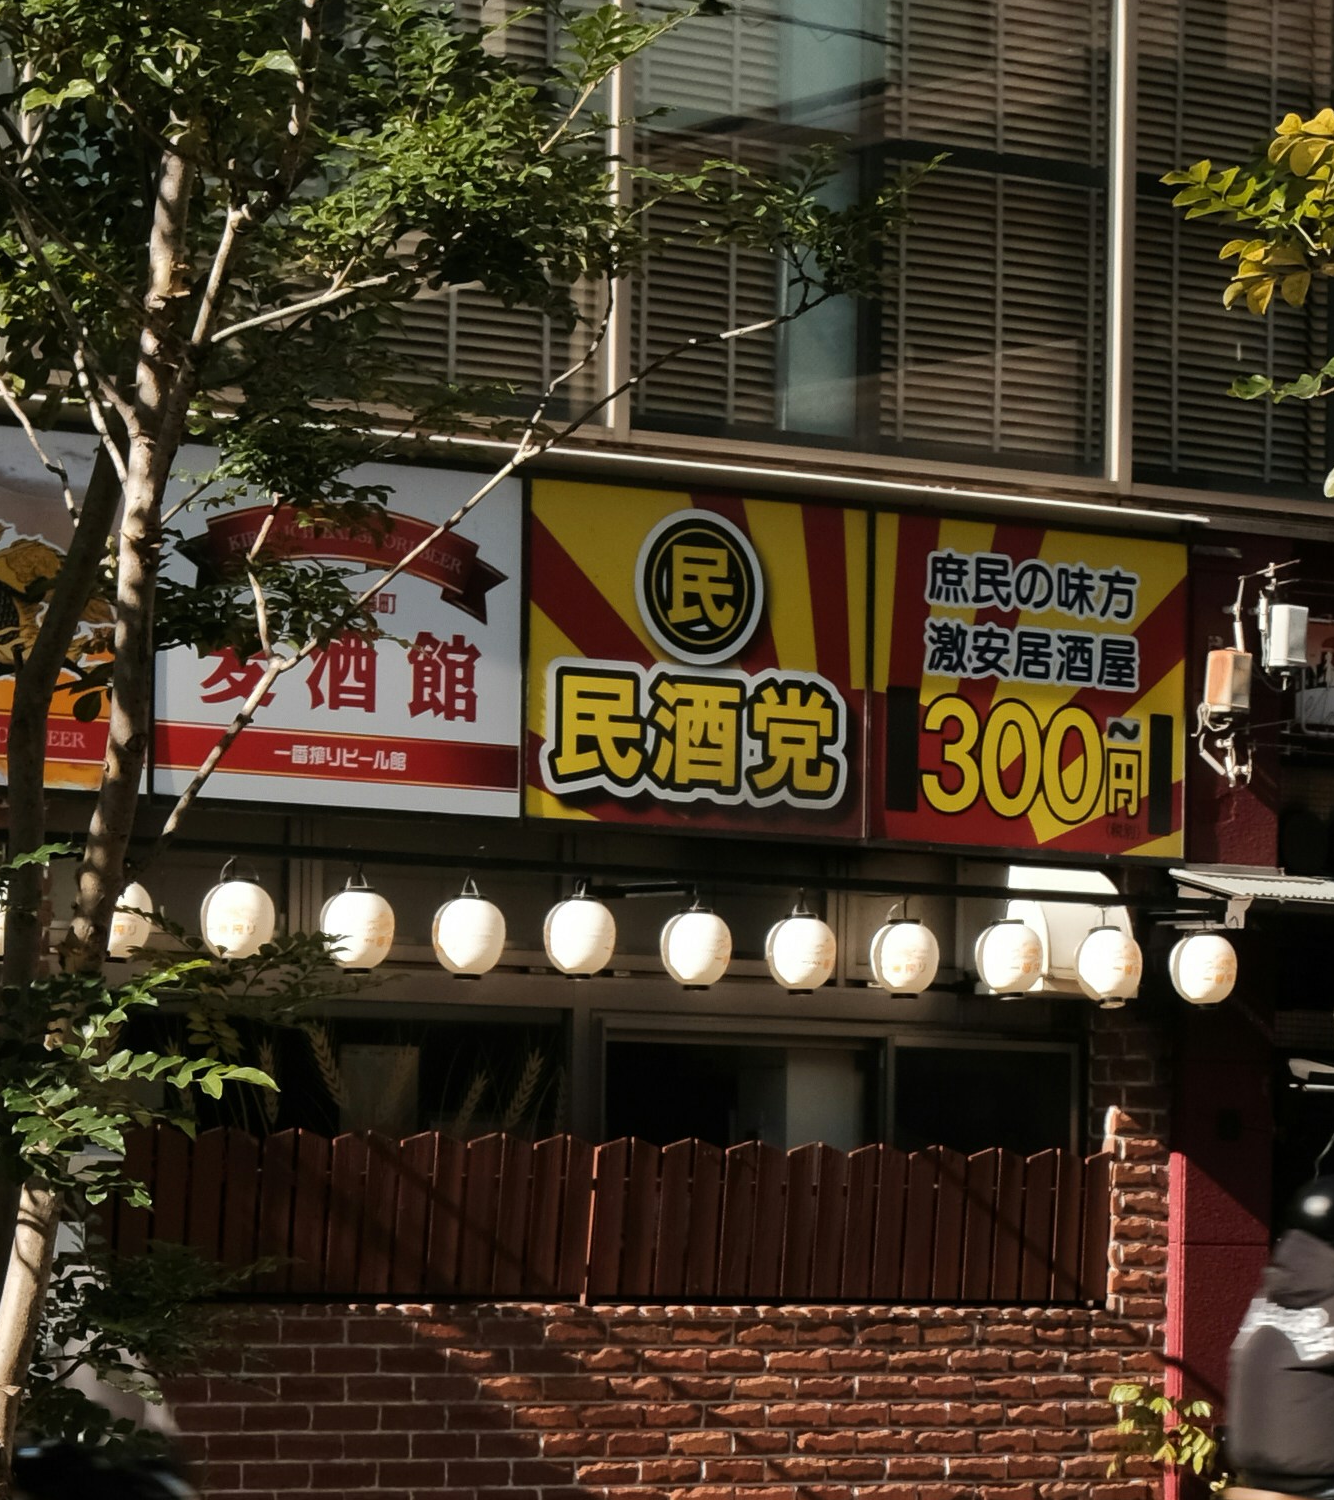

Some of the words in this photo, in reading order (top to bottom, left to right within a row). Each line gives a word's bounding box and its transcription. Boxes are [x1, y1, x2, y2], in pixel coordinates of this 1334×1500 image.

[667, 544, 733, 625] 民
[928, 552, 1137, 620] 庶民の味方
[927, 621, 1137, 689] 激安居酒屋
[552, 671, 837, 796] 民酒党
